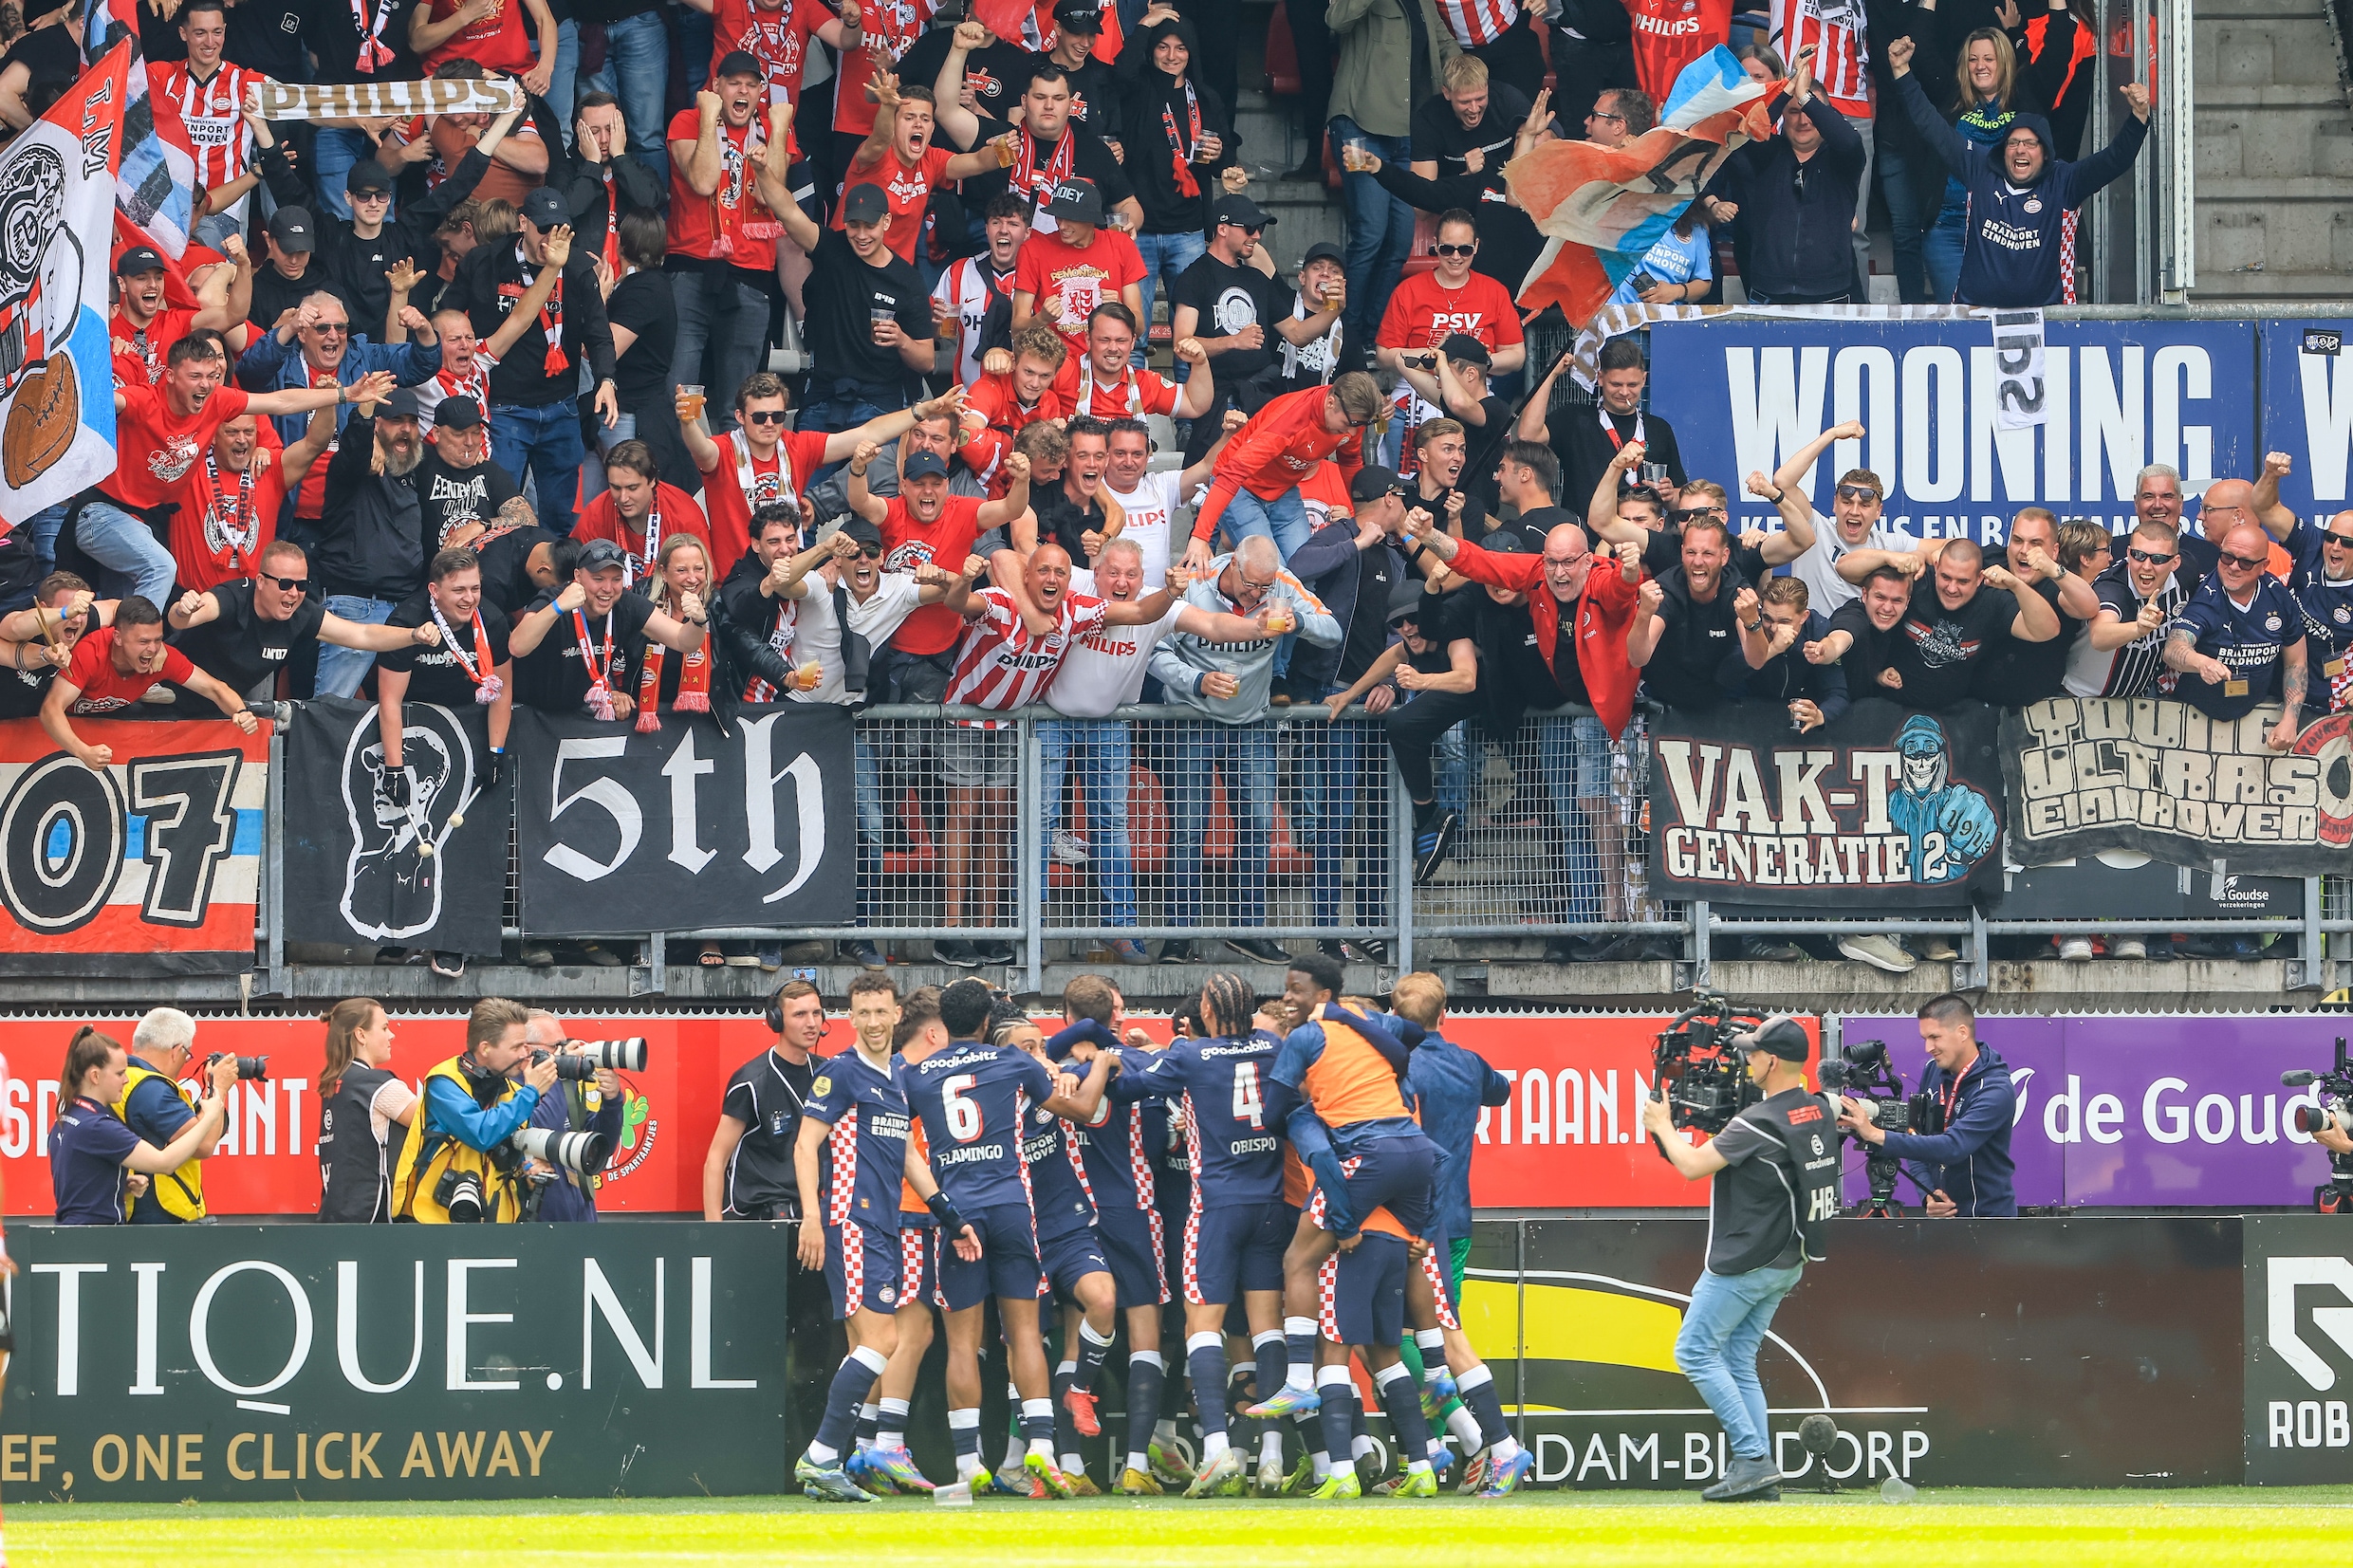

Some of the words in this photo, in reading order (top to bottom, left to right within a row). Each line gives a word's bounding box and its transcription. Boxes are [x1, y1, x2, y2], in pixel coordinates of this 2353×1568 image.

[1635, 12, 1700, 36] PHILIPS
[261, 78, 512, 120] PHILIPS
[1433, 313, 1482, 328] PSV
[1725, 346, 2213, 503] WOONING
[1658, 740, 1901, 835] VAK-T
[2022, 740, 2322, 806] ULTRAS
[2027, 785, 2319, 842] EINDHOVEN
[1665, 827, 1912, 886] GENERATIE
[1922, 831, 1948, 881] 2
[2218, 901, 2266, 910] verzekeringen
[2228, 888, 2270, 902] Goudse
[919, 1050, 997, 1075] goodhabitz
[1200, 1038, 1273, 1061] goodhabitz
[941, 1074, 984, 1144] 6
[1232, 1061, 1266, 1131] 4
[2043, 1073, 2124, 1145] de
[607, 1171, 620, 1182] DE
[621, 1119, 658, 1178] SPARTAANTJES
[937, 1144, 1003, 1167] FLAMINGO
[1231, 1136, 1277, 1155] OBISPO
[2269, 1400, 2350, 1448] ROB
[92, 1432, 204, 1482] ONE
[227, 1431, 383, 1481] CLICK
[399, 1430, 553, 1478] AWAY
